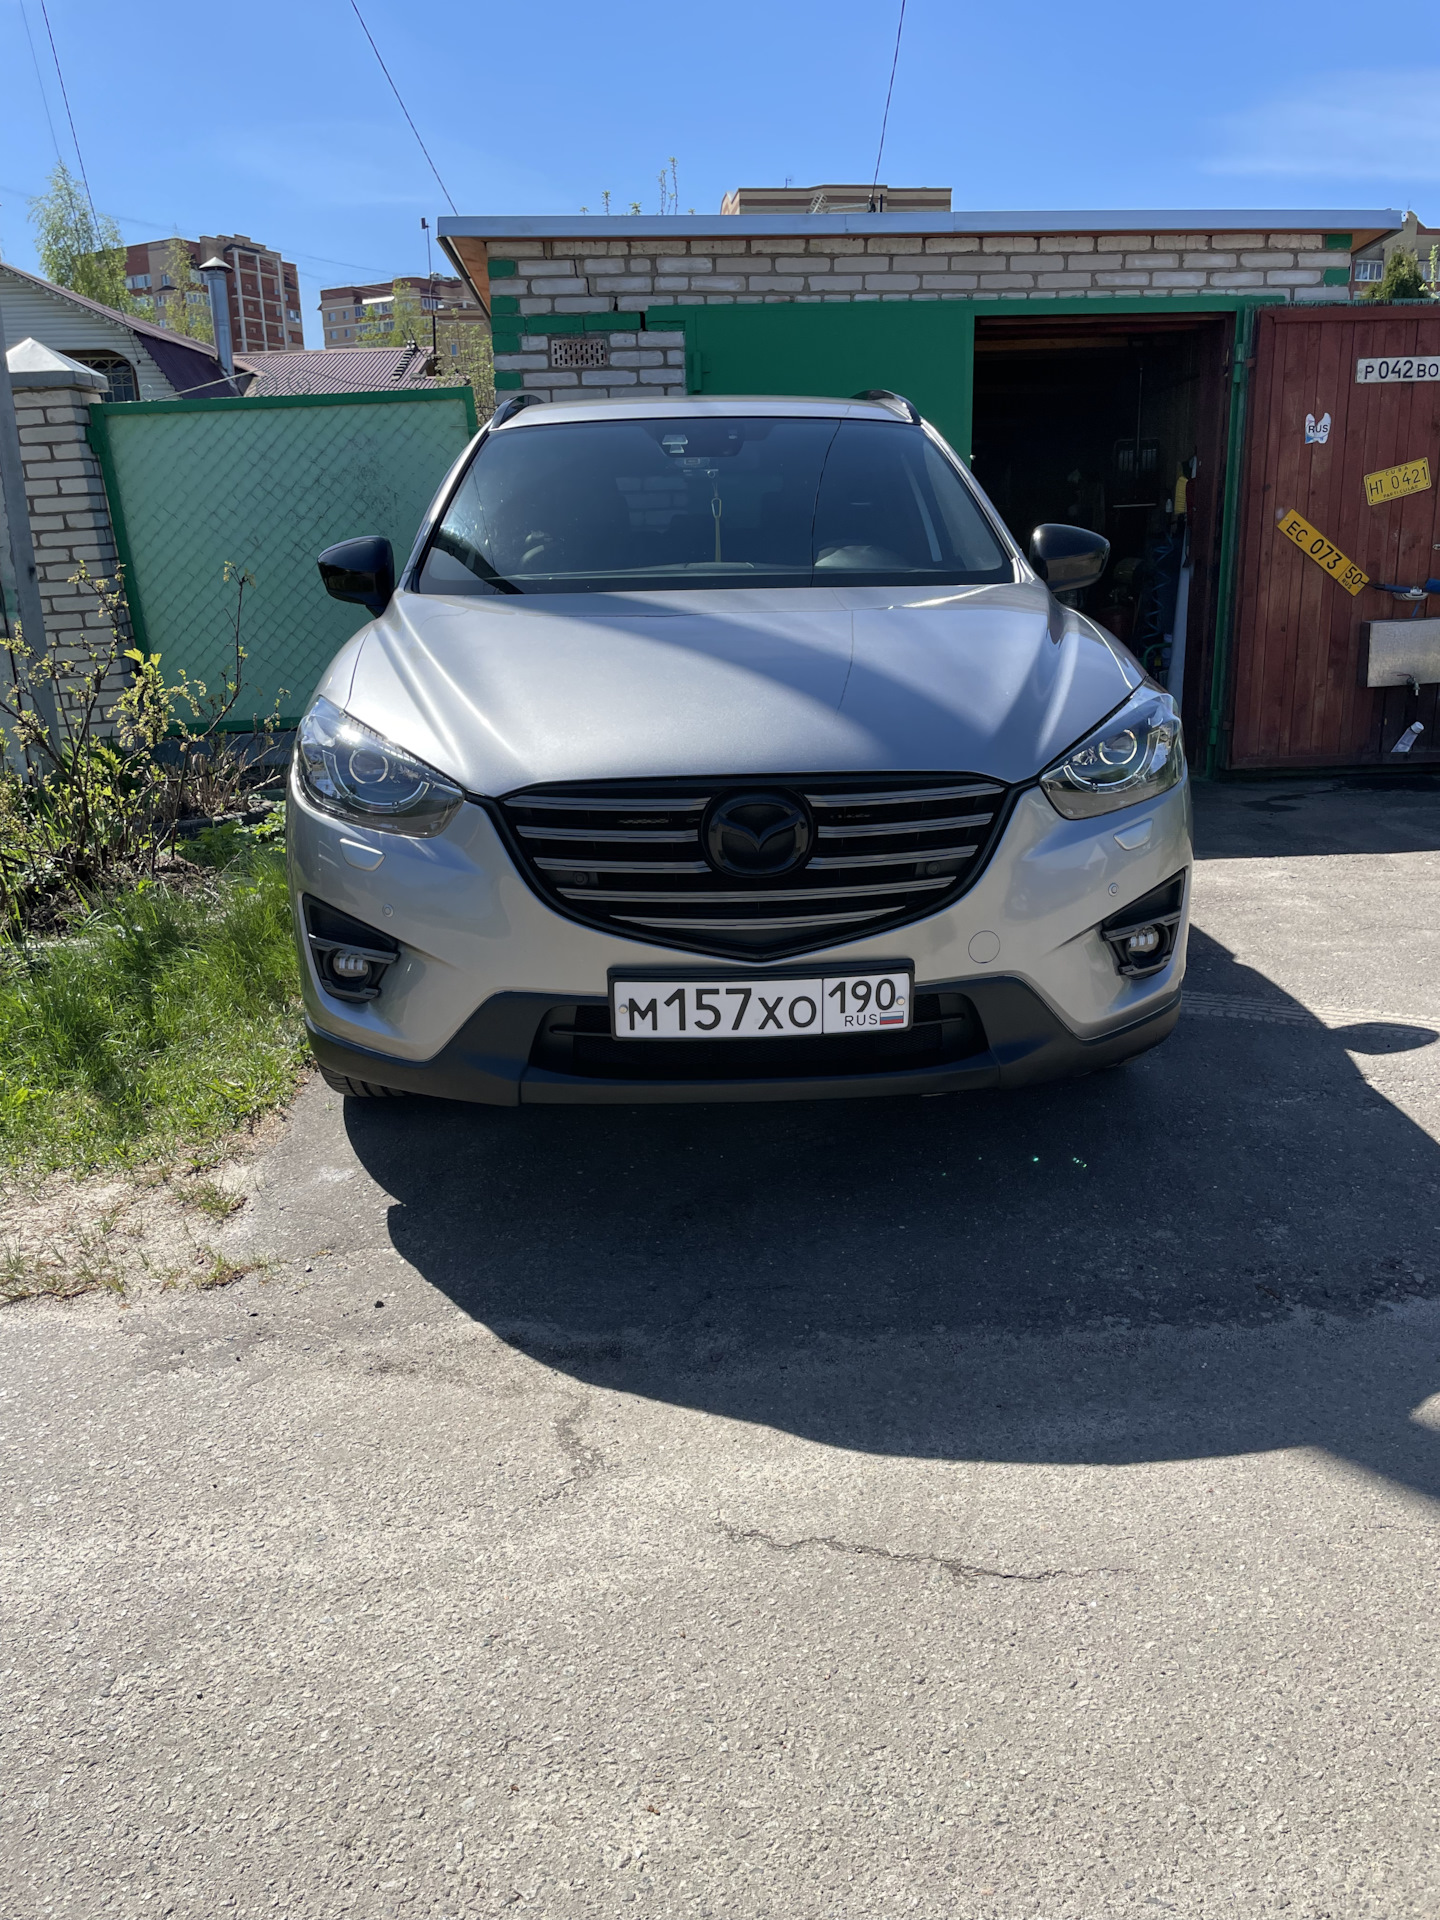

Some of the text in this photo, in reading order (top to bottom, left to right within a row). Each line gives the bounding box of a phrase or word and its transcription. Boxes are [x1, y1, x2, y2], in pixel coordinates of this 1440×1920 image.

[1308, 424, 1329, 434] RUS
[1391, 466, 1427, 490] 0421
[1310, 538, 1343, 570] 073
[828, 978, 896, 1014] 190
[844, 1012, 878, 1027] RUS
